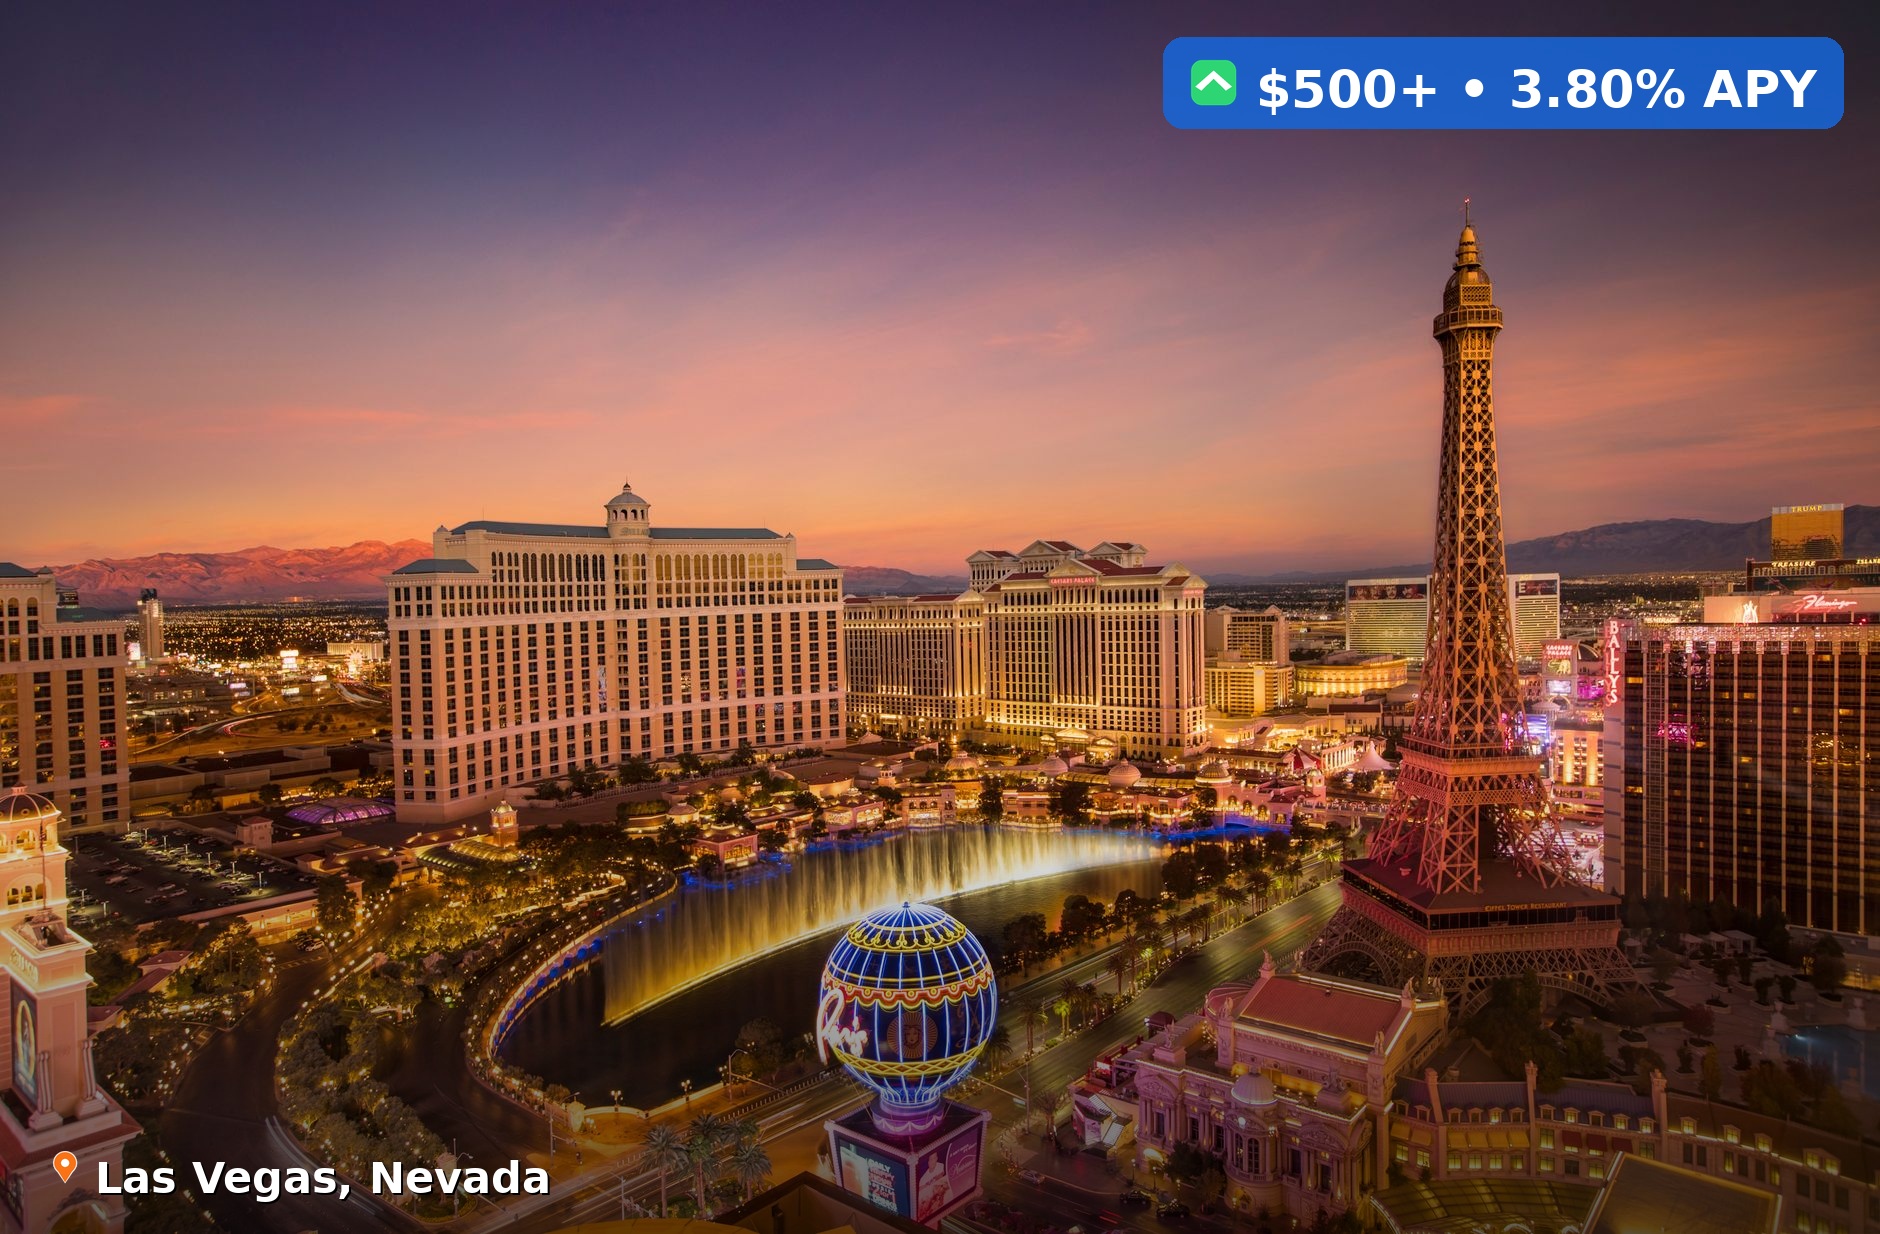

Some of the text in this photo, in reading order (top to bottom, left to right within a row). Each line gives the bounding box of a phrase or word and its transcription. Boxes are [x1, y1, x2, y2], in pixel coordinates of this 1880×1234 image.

[1791, 505, 1823, 513] TRUMP
[1771, 560, 1816, 568] TREASURE
[1802, 594, 1858, 610] Flamingo
